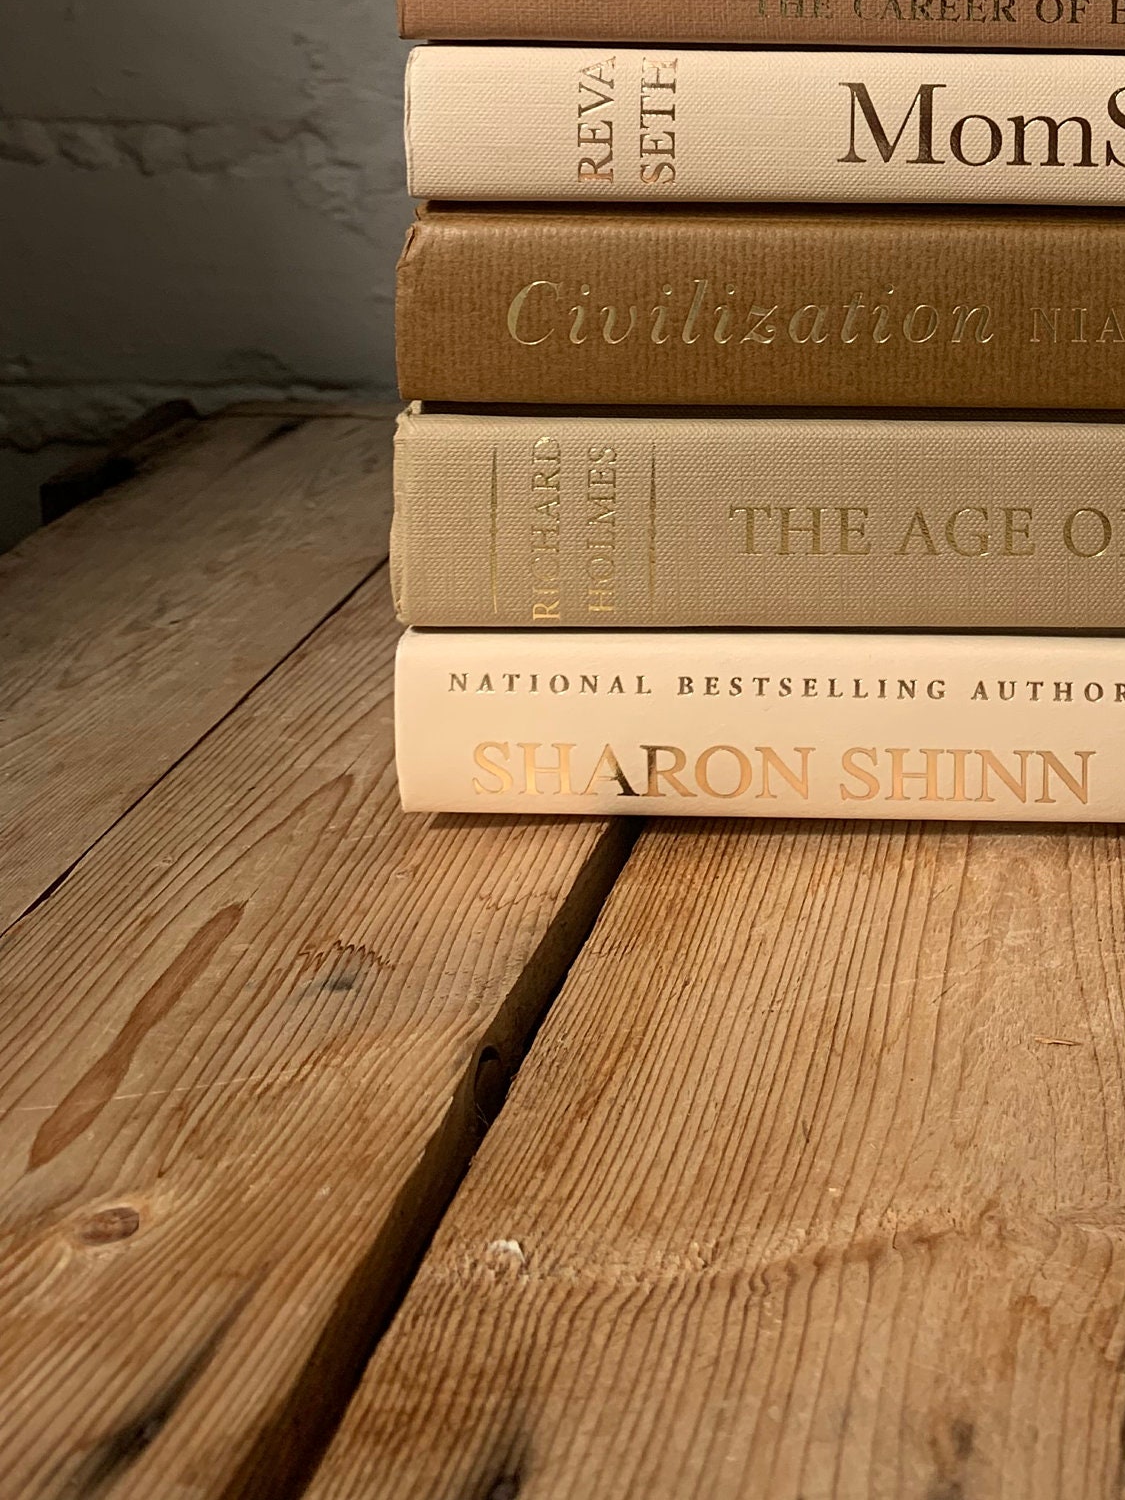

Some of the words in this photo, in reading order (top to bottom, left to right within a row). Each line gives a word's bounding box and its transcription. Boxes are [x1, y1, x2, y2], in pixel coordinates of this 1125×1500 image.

[577, 55, 617, 185] REVA
[639, 56, 678, 185] SETH
[506, 278, 995, 345] Civilization
[532, 436, 561, 621] RICHARD
[587, 447, 617, 613] HOLMES
[729, 505, 870, 557] THE
[895, 506, 1035, 559] AGE
[448, 673, 653, 697] NATIONAL
[677, 676, 948, 700] BESTSELLING
[471, 740, 816, 800] SHARON
[839, 745, 1097, 805] SHINN
